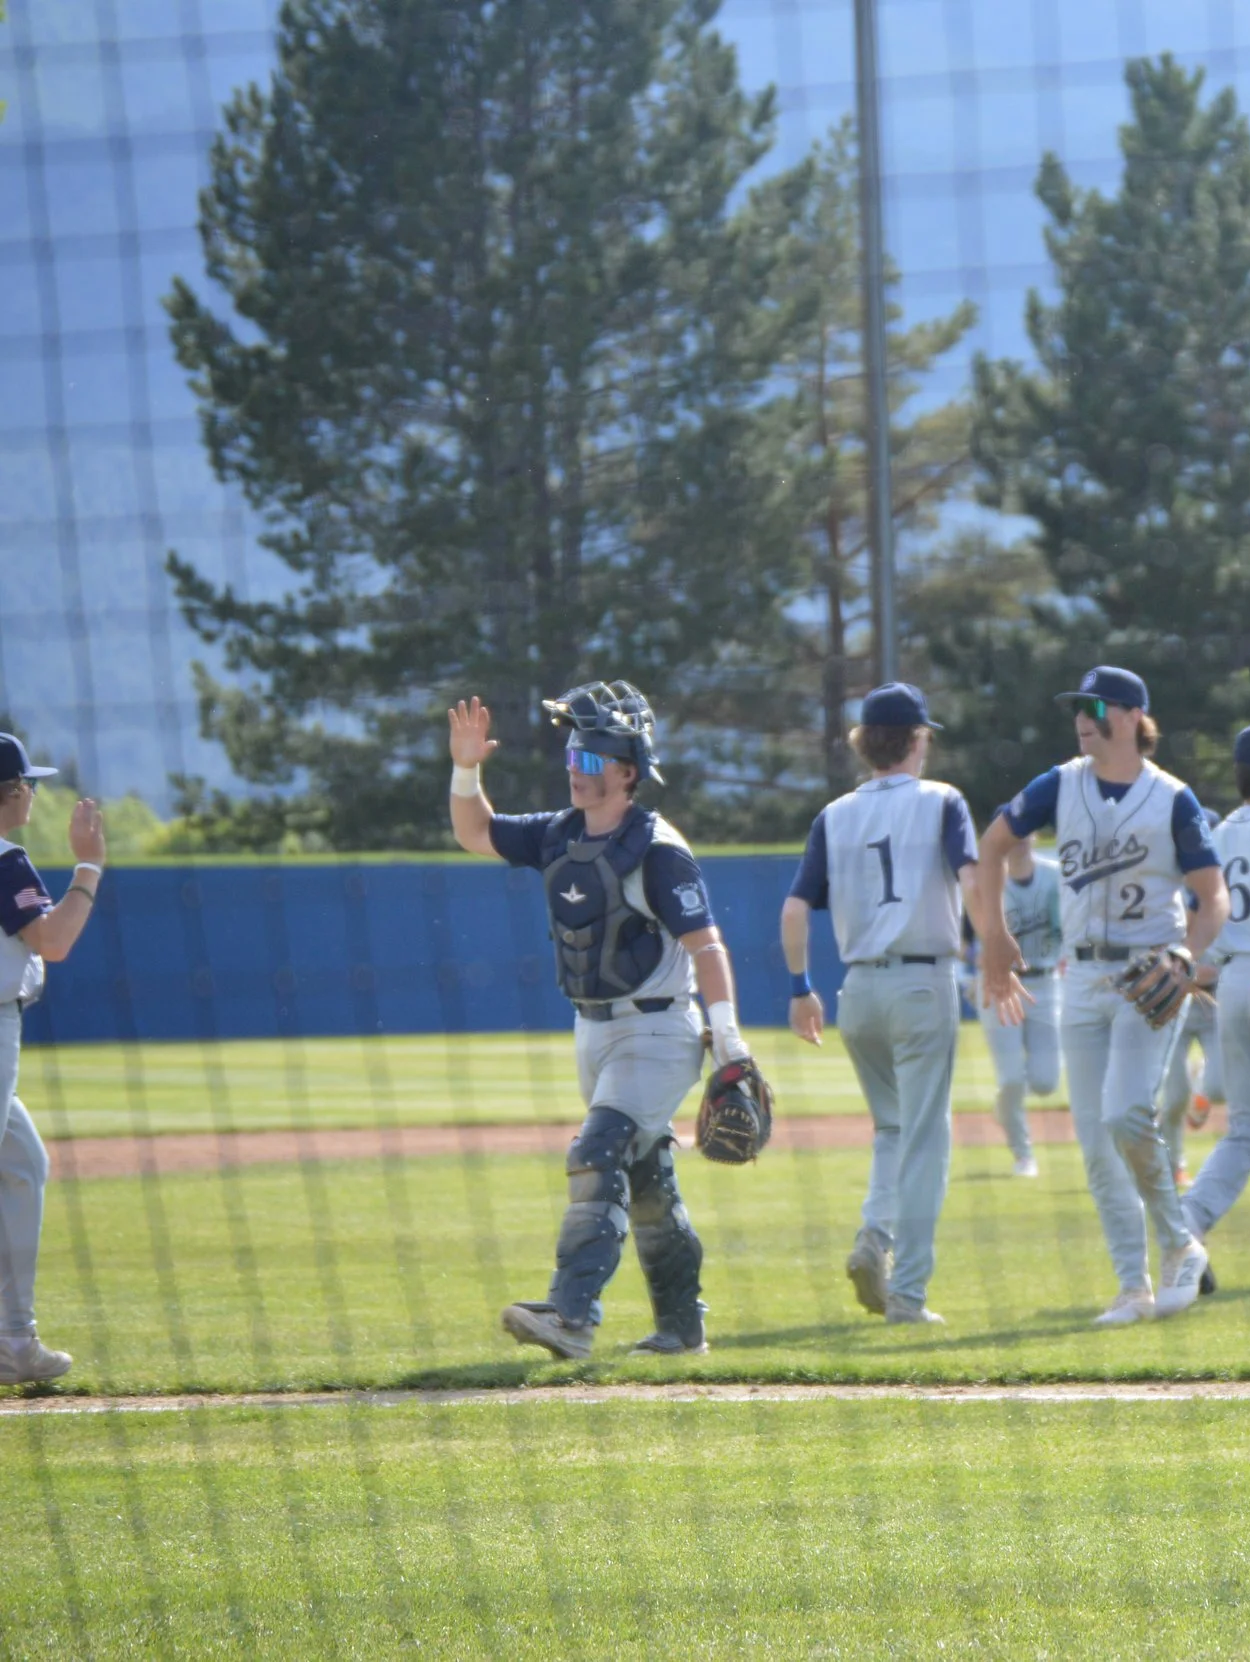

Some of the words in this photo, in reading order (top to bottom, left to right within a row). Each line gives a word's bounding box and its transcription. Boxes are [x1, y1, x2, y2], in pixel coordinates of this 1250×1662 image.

[866, 833, 903, 907] 1
[1059, 833, 1140, 877] Bucs
[1120, 883, 1146, 920] 2
